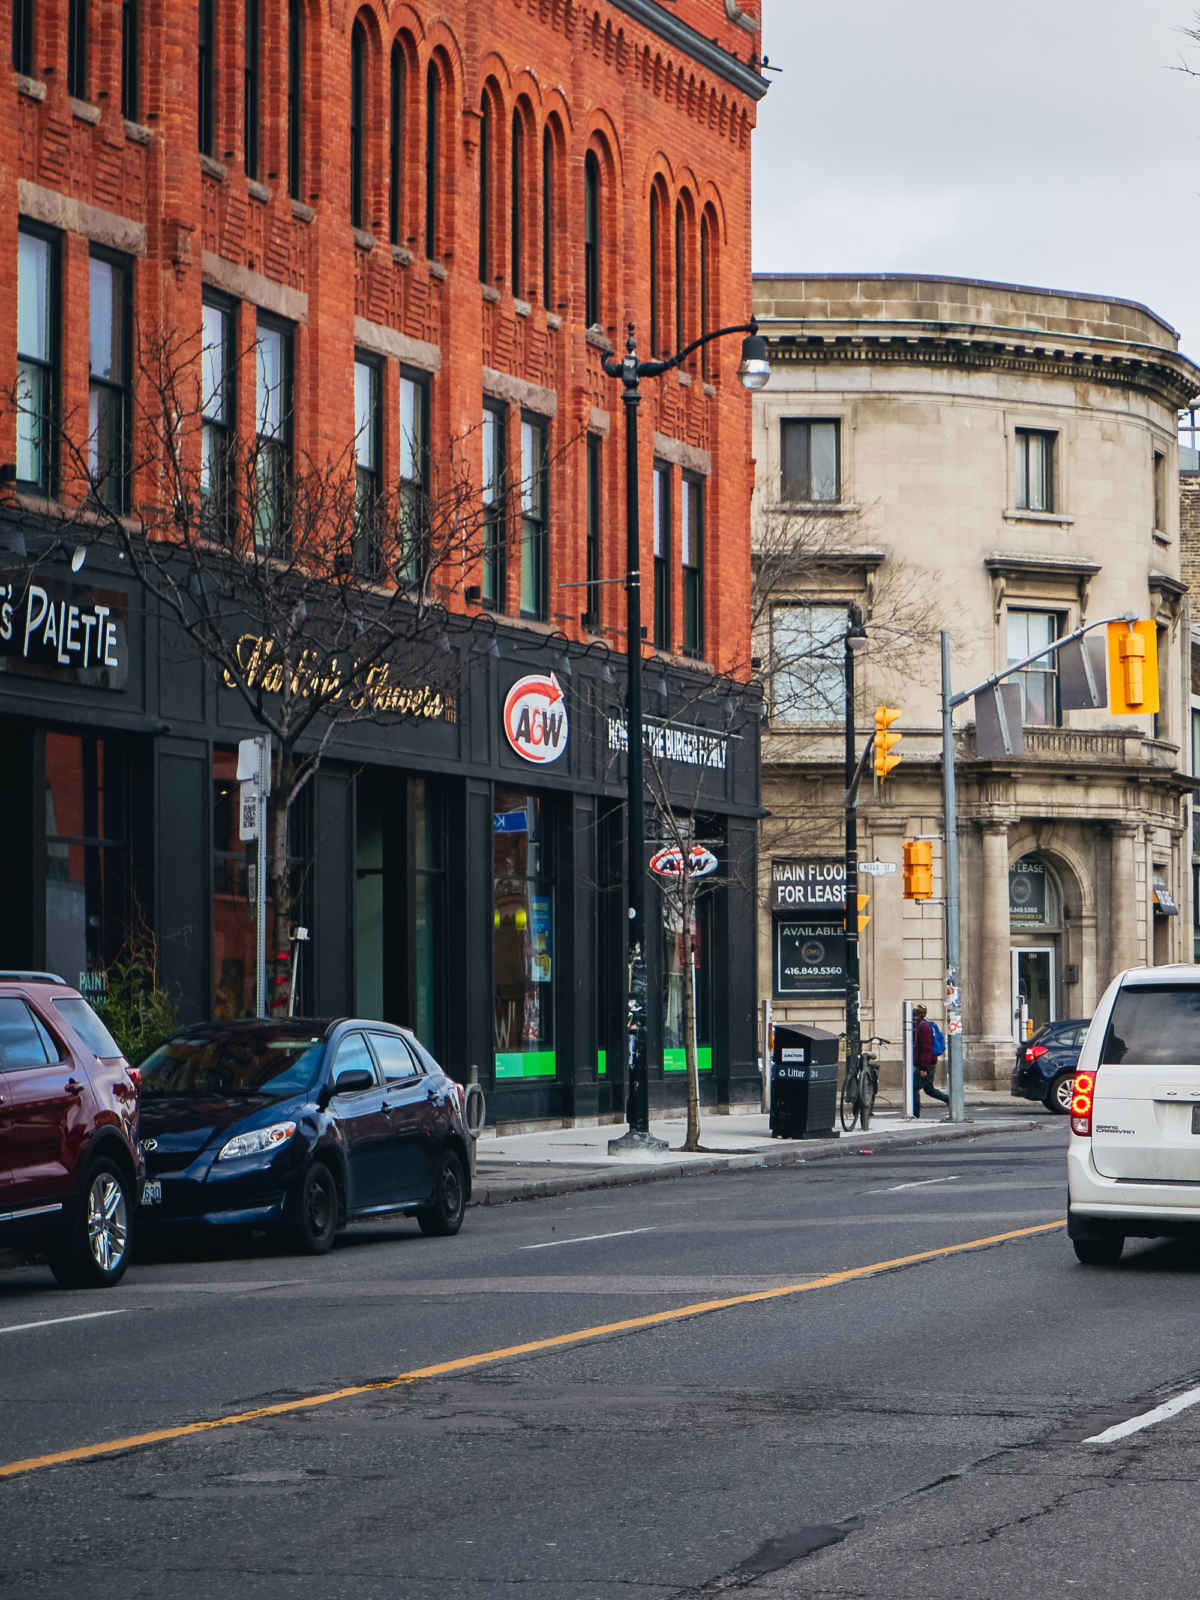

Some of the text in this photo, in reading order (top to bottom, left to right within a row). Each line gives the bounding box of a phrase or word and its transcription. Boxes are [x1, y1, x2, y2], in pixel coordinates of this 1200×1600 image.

[23, 584, 119, 669] PALETTE
[515, 706, 563, 747] A&W
[647, 724, 665, 758] THE
[665, 728, 698, 765] BURGER
[772, 864, 806, 881] MAIN
[808, 864, 847, 881] FLOO
[777, 886, 804, 903] FOR
[783, 927, 844, 936] AVAILABLE
[787, 1067, 806, 1078] Litter
